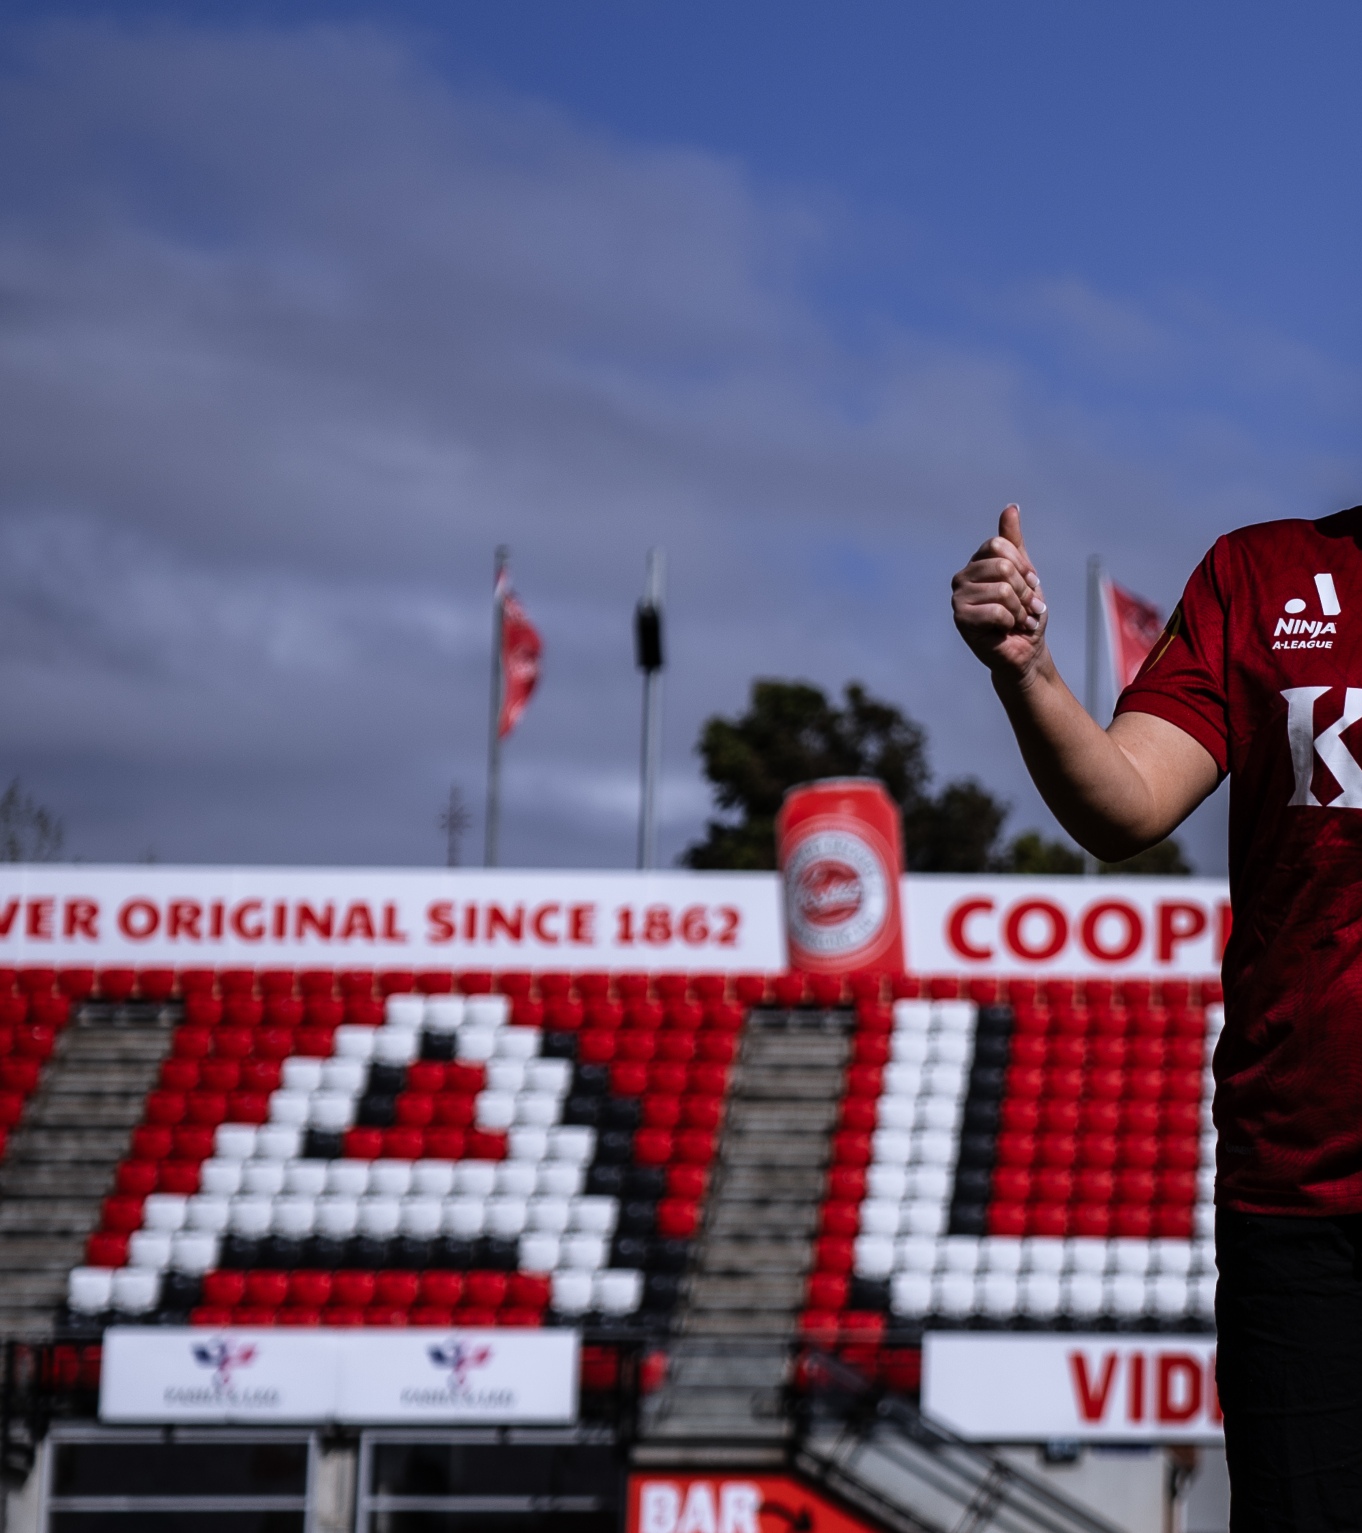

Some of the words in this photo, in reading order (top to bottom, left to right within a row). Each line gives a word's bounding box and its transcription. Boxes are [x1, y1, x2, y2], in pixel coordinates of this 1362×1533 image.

[1272, 640, 1334, 650] A-LEAGUE
[1273, 617, 1337, 639] NINJA
[117, 897, 406, 944] ORIGINAL
[427, 901, 593, 945] SINCE
[616, 905, 742, 947] 1862
[639, 1480, 765, 1533] BAR
